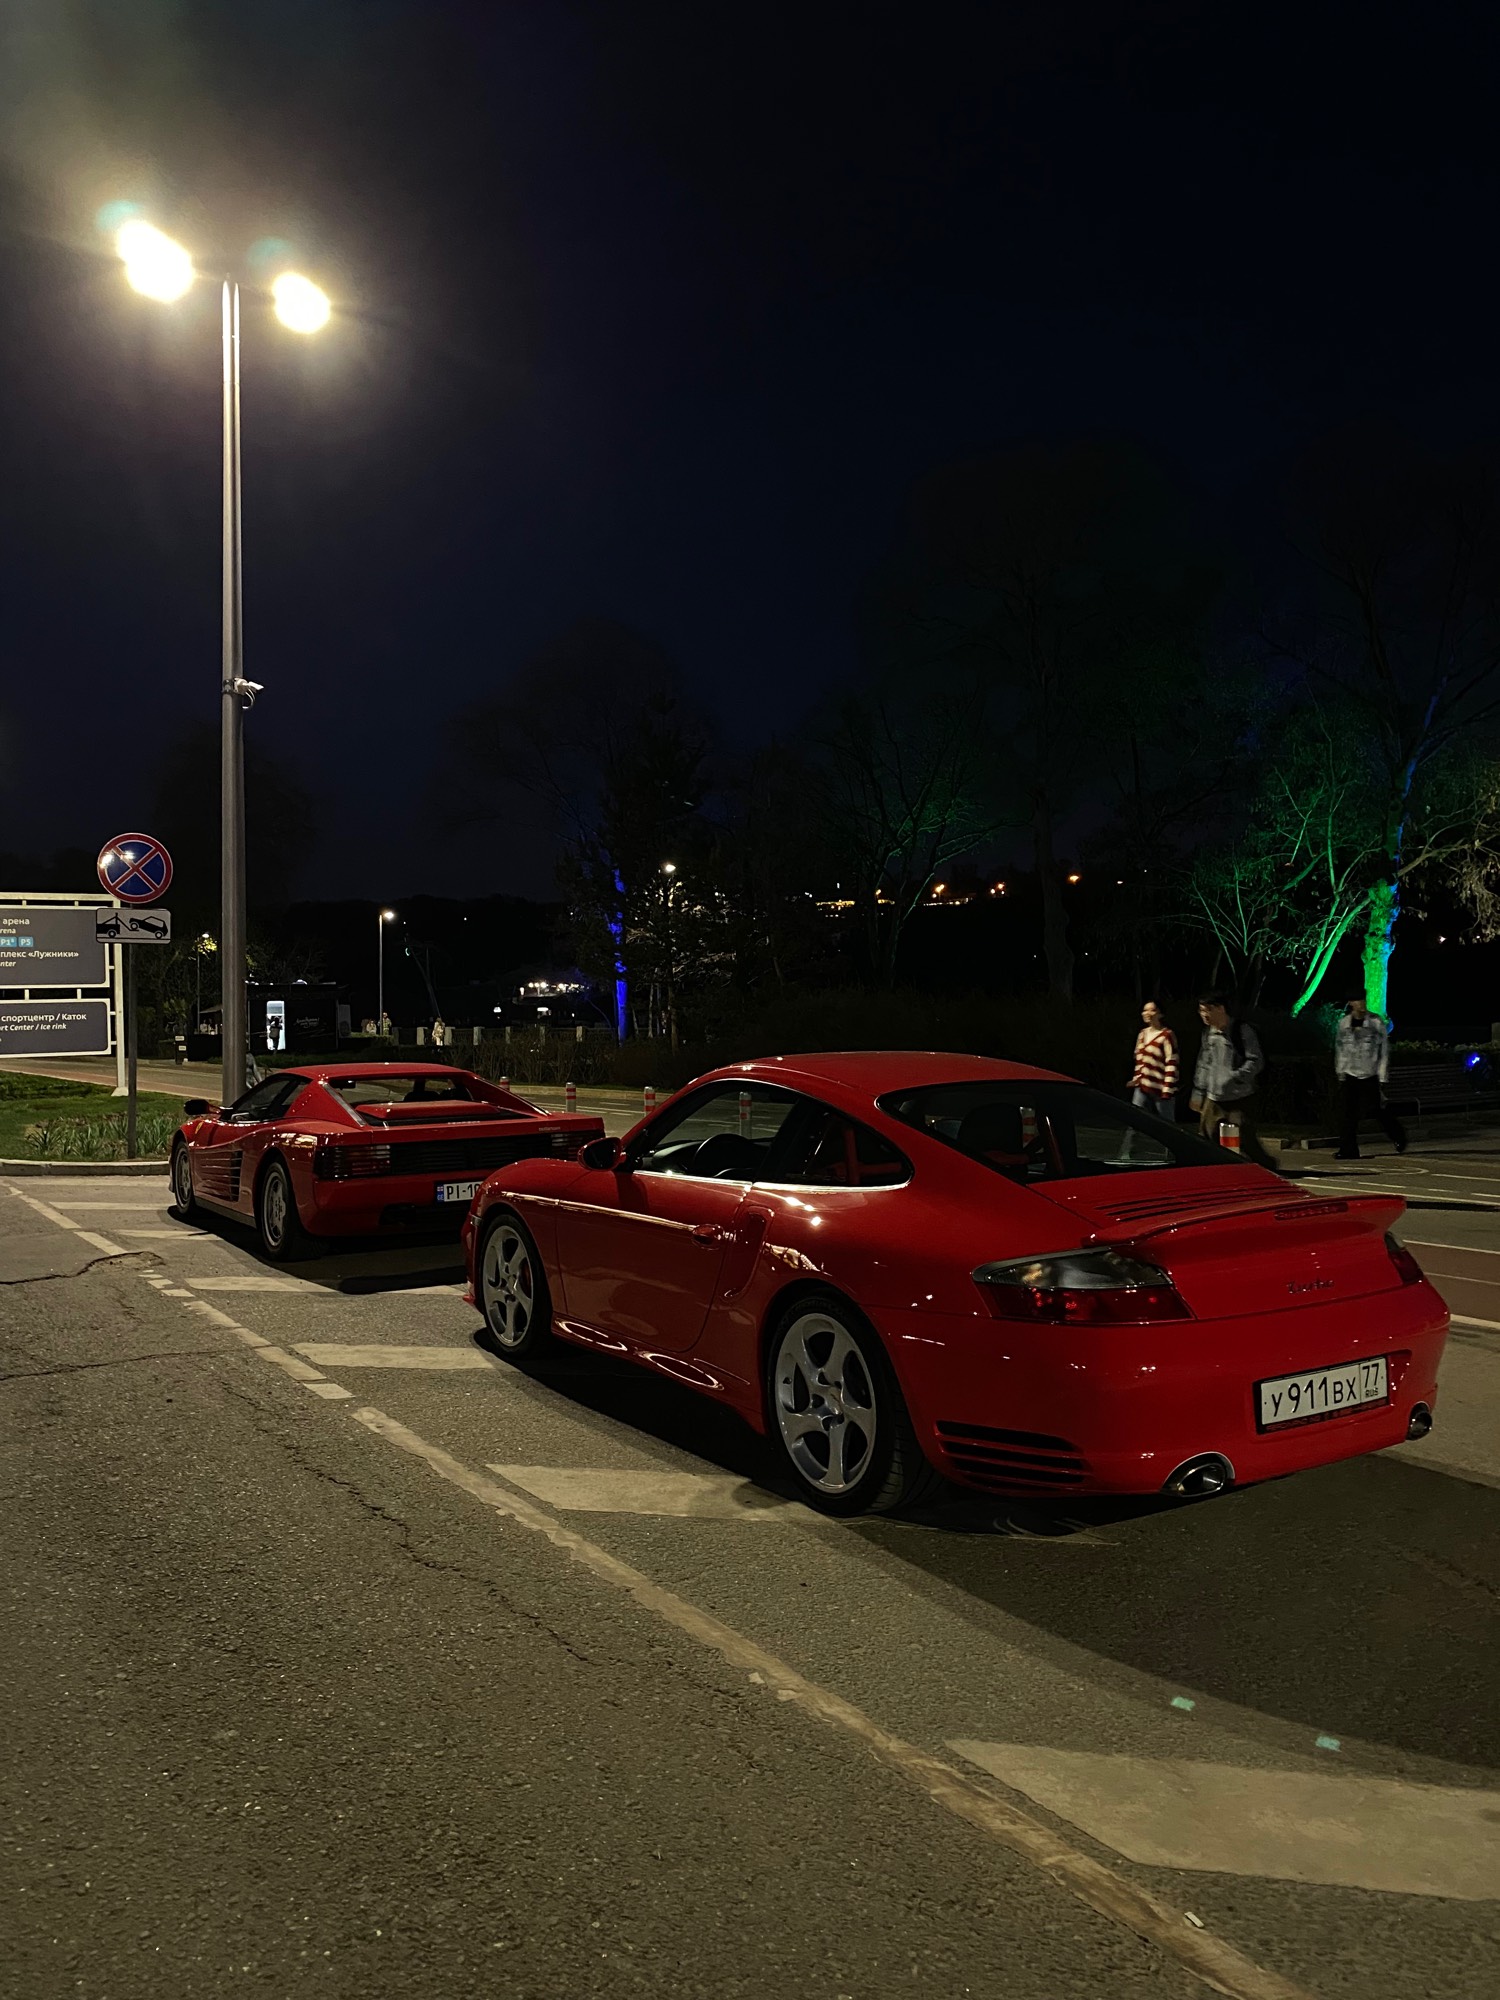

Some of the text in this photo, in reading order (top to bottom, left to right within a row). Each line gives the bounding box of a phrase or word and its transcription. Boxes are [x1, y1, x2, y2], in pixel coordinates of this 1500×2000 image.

[3, 918, 30, 926] арена
[20, 938, 31, 946] P5
[28, 950, 80, 960] «Лужники»
[1, 1014, 55, 1023] спортцентр
[61, 1013, 87, 1021] Каток
[9, 1023, 34, 1031] Center
[52, 1022, 67, 1030] rink
[1362, 1362, 1380, 1388] 77
[1364, 1387, 1379, 1398] RUS
